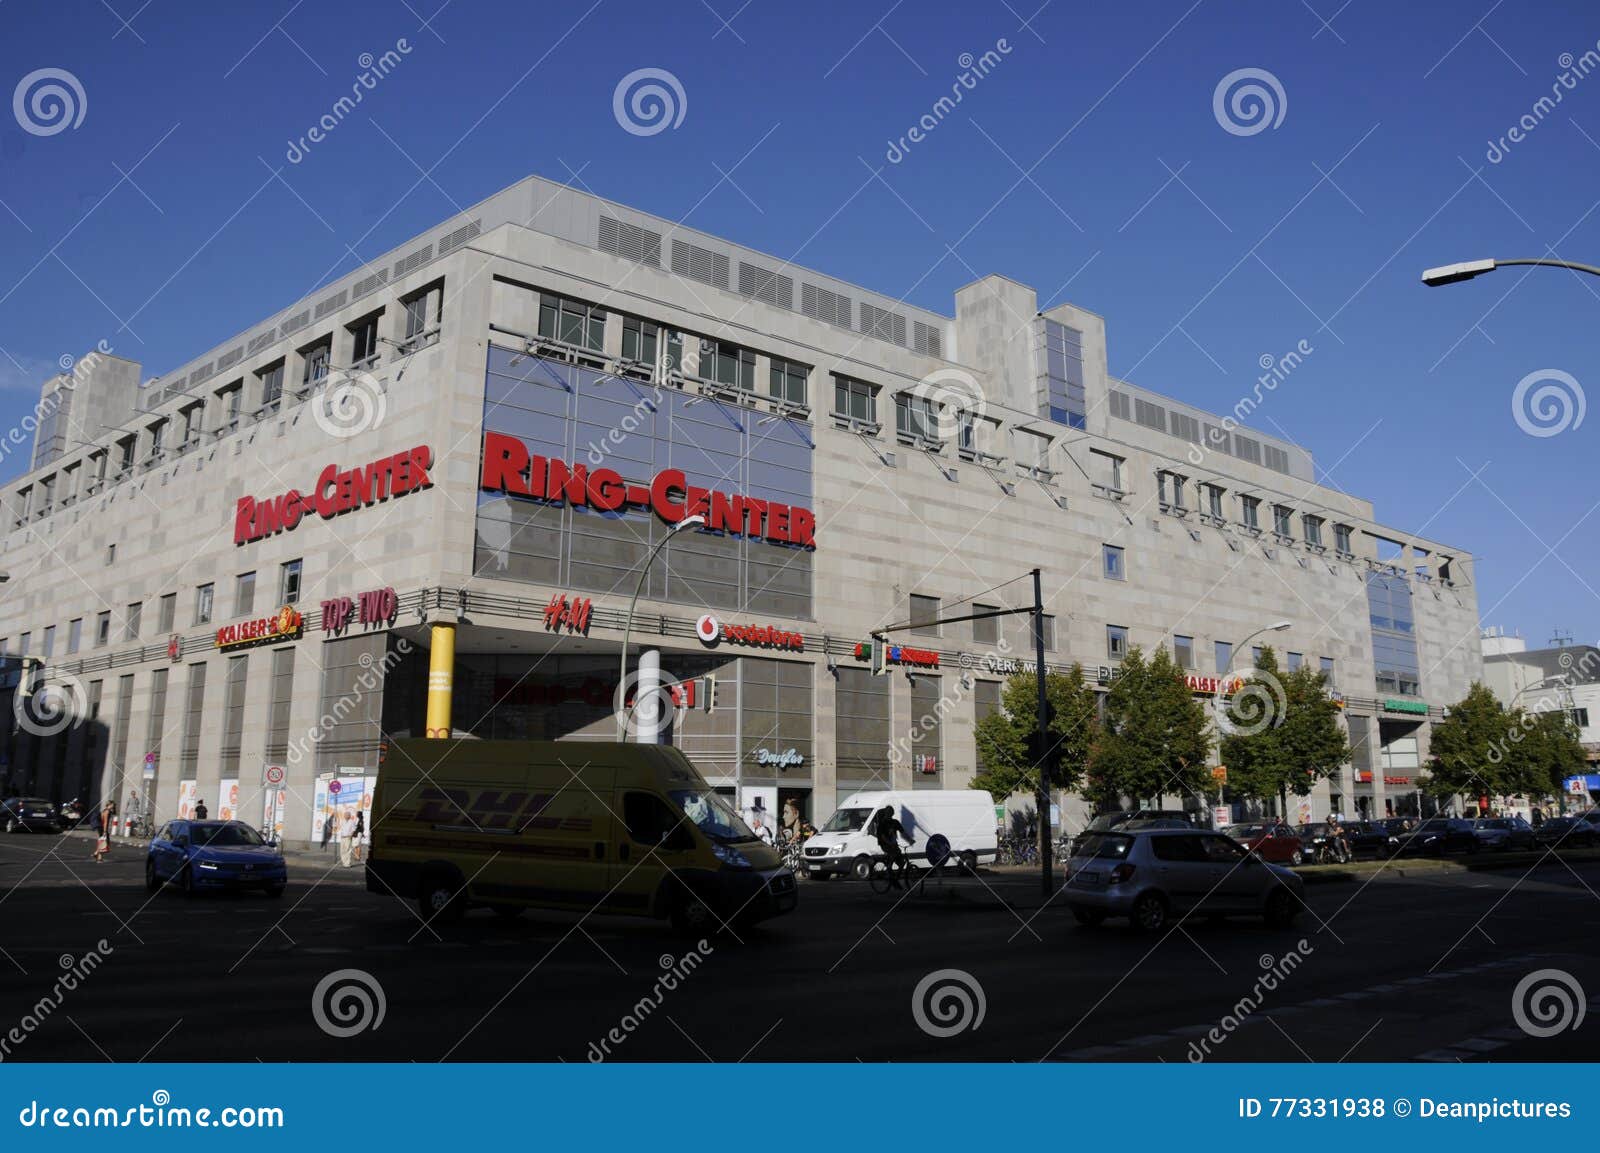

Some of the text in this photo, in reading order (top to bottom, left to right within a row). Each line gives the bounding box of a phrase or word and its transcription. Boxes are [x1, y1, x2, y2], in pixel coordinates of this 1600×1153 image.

[233, 445, 434, 546] RING-CENTER
[482, 431, 816, 552] RING-CENTER
[217, 615, 279, 645] KAISER'S
[320, 587, 397, 632] TOP TWO
[542, 593, 592, 636] H&M
[723, 622, 804, 648] vodafone
[416, 788, 561, 828] DHL
